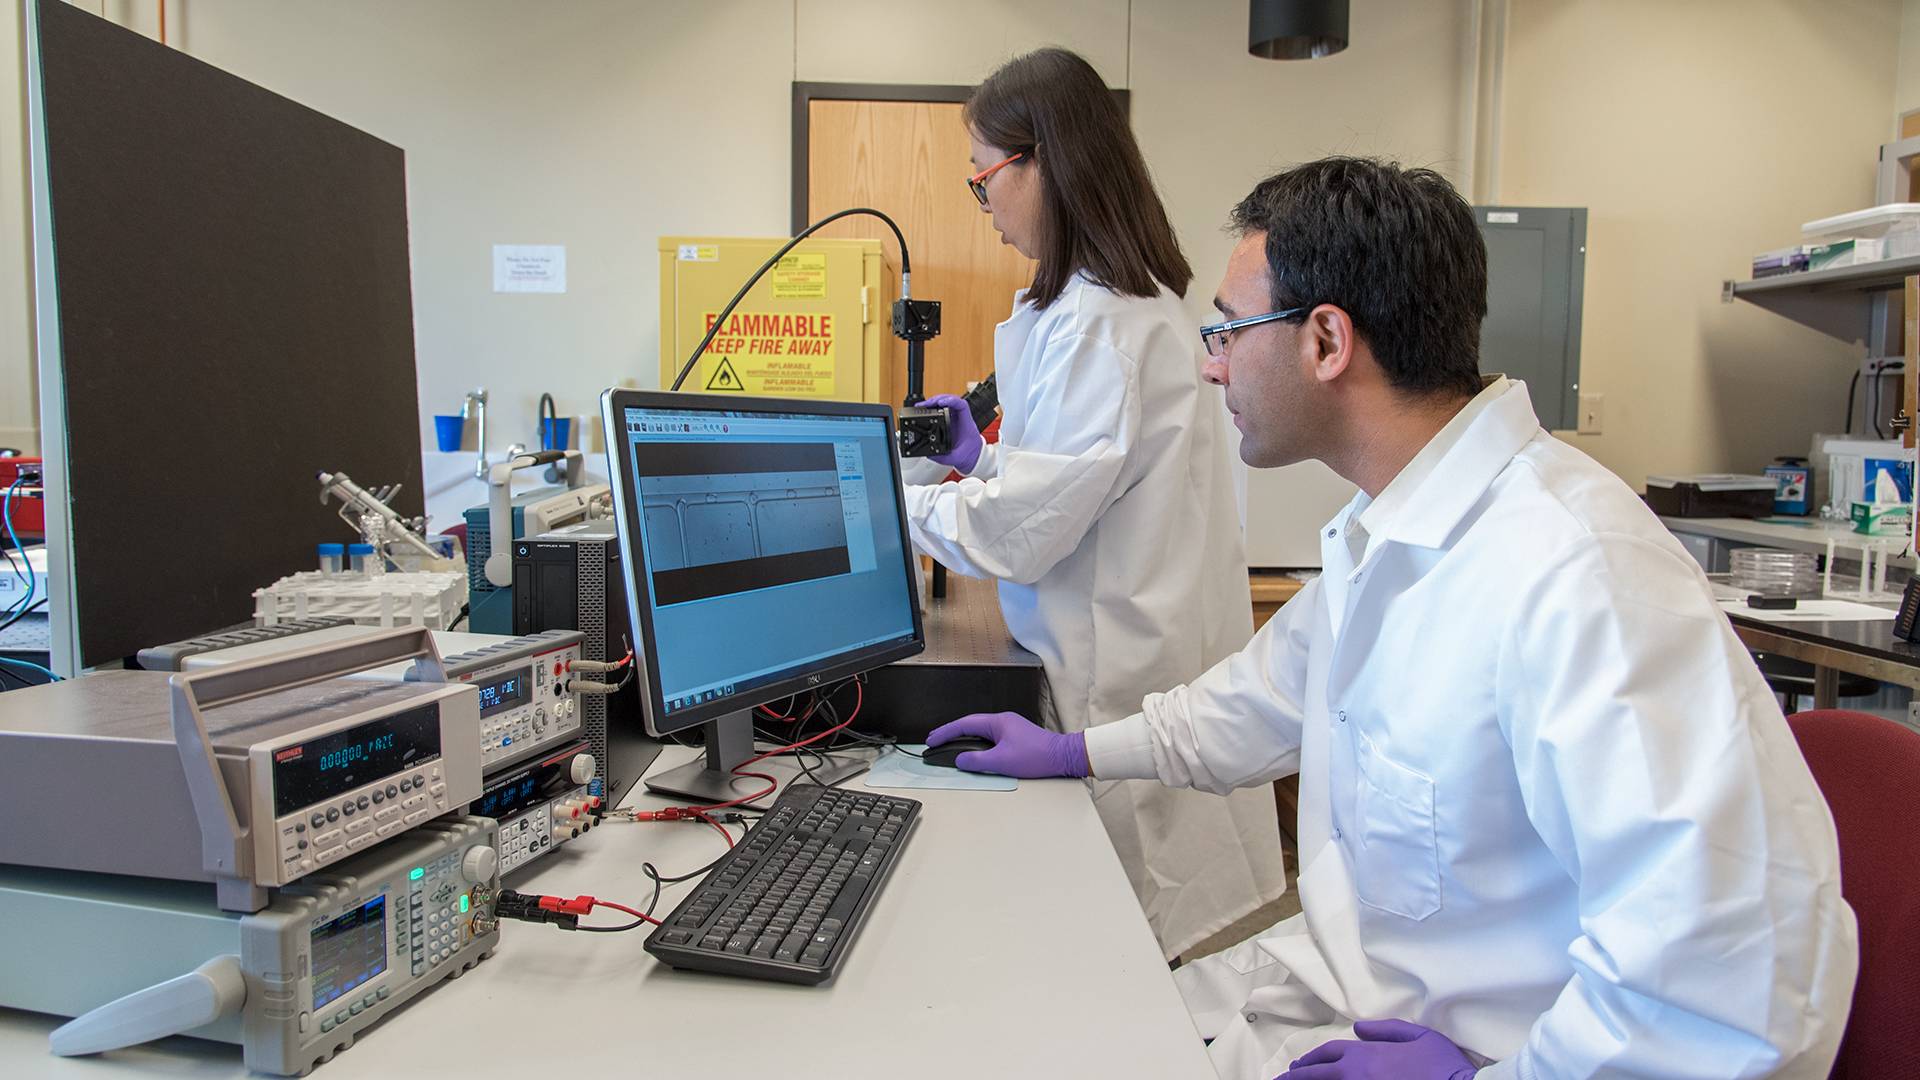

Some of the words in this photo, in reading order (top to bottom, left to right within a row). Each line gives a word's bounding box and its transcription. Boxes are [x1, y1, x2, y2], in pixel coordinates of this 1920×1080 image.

[705, 313, 832, 338] FLAMMABLE
[704, 338, 745, 355] KEEP
[748, 338, 784, 356] FIRE
[786, 339, 833, 356] AWAY
